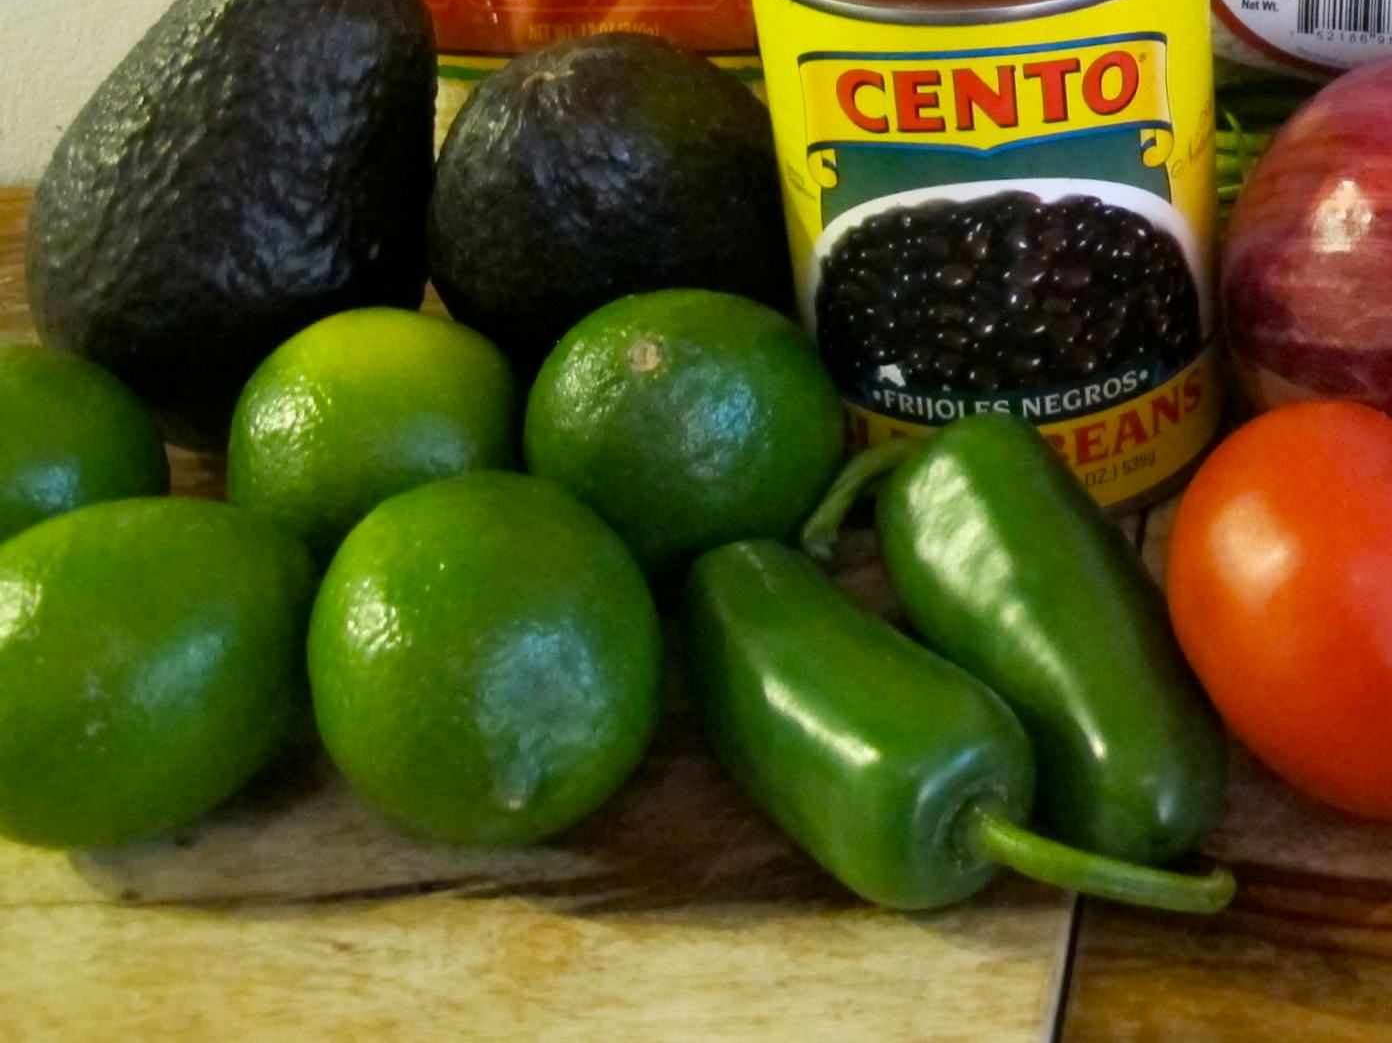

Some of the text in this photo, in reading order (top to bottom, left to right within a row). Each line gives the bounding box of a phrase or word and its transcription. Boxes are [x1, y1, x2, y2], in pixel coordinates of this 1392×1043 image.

[1262, 0, 1279, 12] Wt.
[1316, 30, 1368, 44] 52186
[835, 50, 1140, 134] CENTO
[1022, 369, 1138, 418] NEGROS
